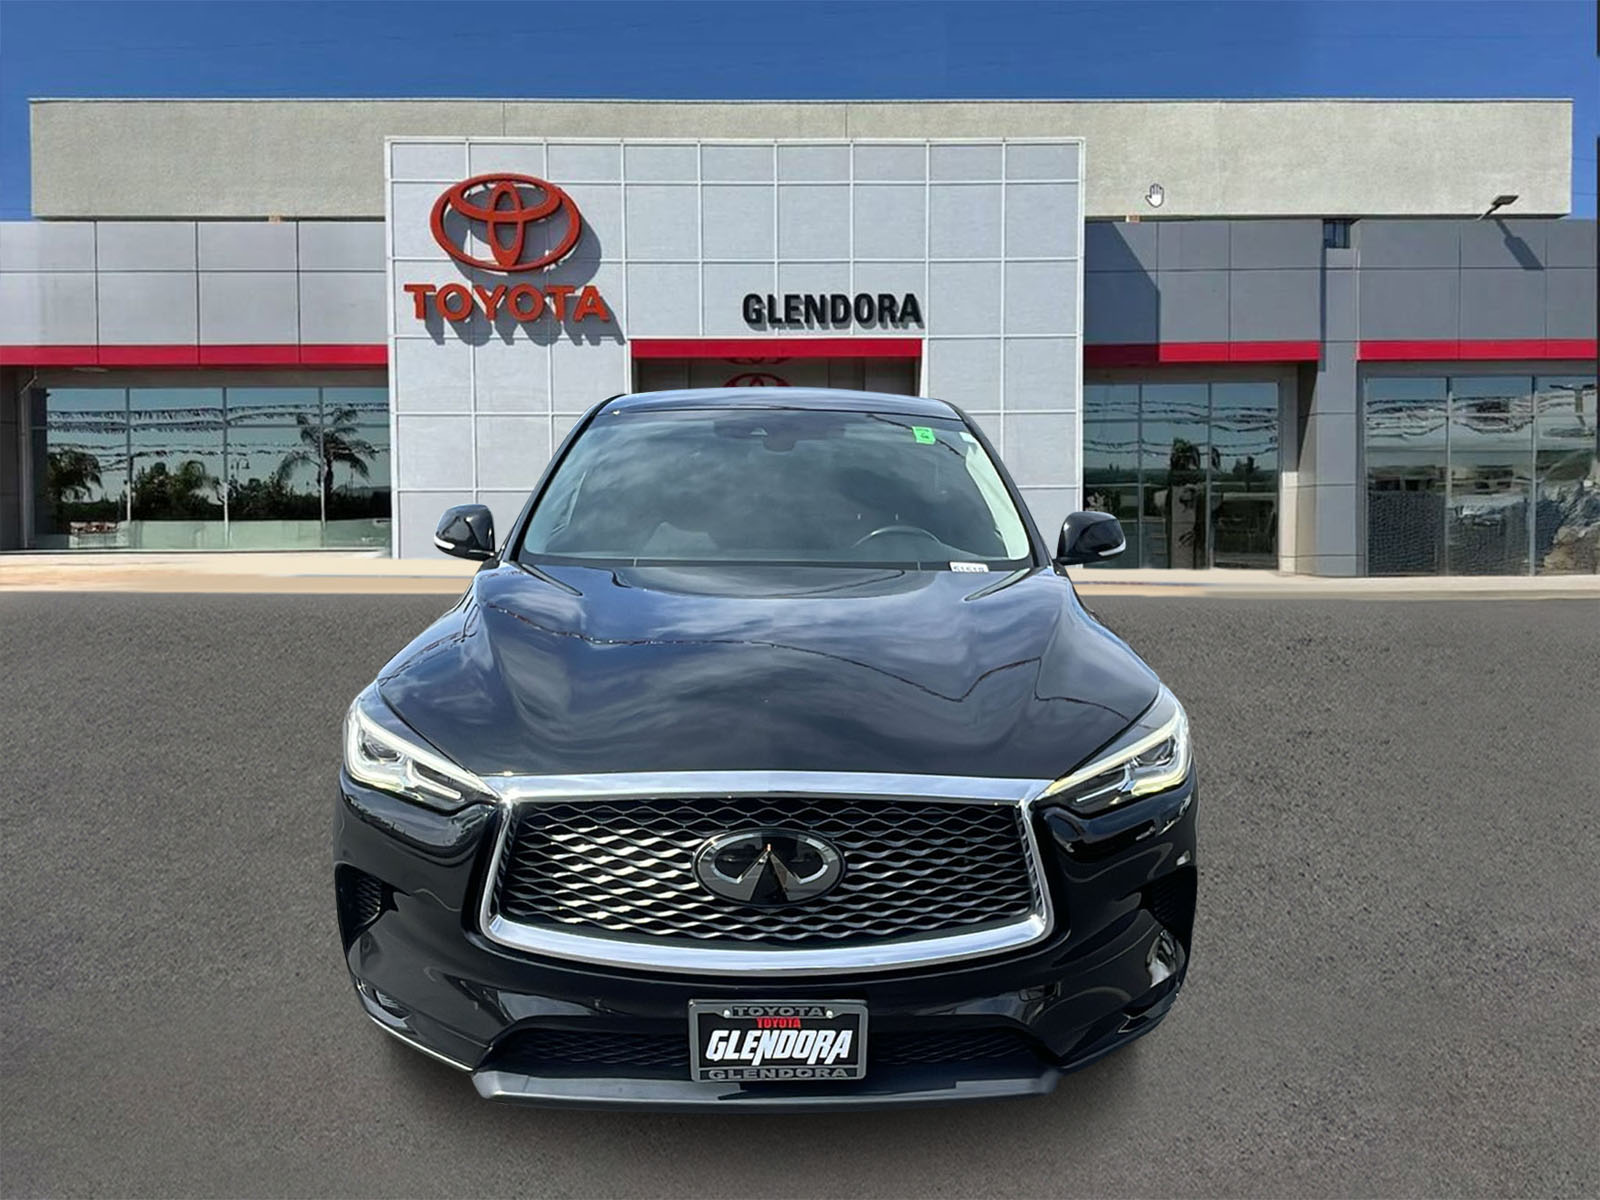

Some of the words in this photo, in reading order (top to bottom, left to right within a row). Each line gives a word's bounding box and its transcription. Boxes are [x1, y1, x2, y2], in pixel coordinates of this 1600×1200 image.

[404, 284, 610, 322] TOYOTA
[743, 293, 922, 324] GLENDORA
[733, 1006, 824, 1017] TOYOTA
[756, 1017, 801, 1029] TOYOTA
[706, 1030, 853, 1066] GLENDORA
[708, 1067, 849, 1080] GLENDORA
